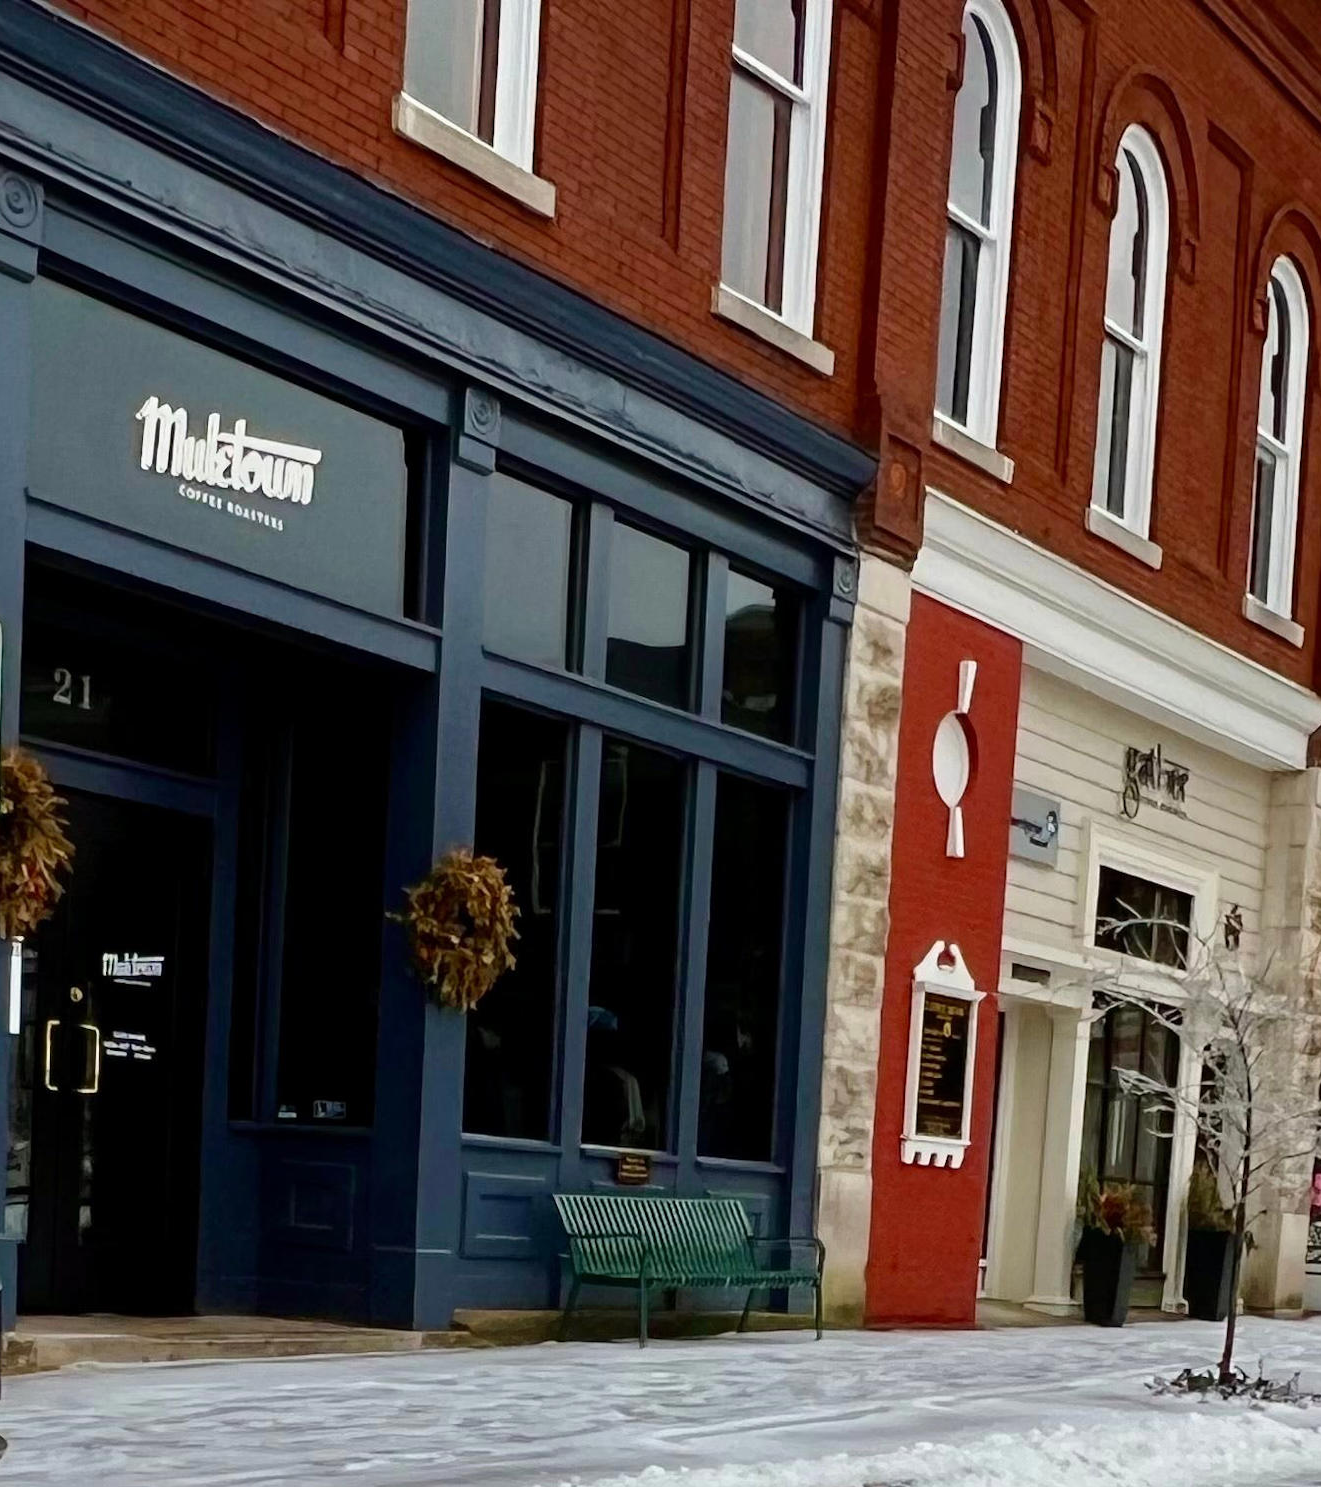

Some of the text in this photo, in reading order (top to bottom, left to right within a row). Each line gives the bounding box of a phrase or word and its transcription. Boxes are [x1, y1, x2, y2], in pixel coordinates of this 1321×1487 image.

[134, 395, 323, 506] Muletown
[178, 483, 284, 532] COFFEE ROASTERS
[52, 667, 92, 711] 21
